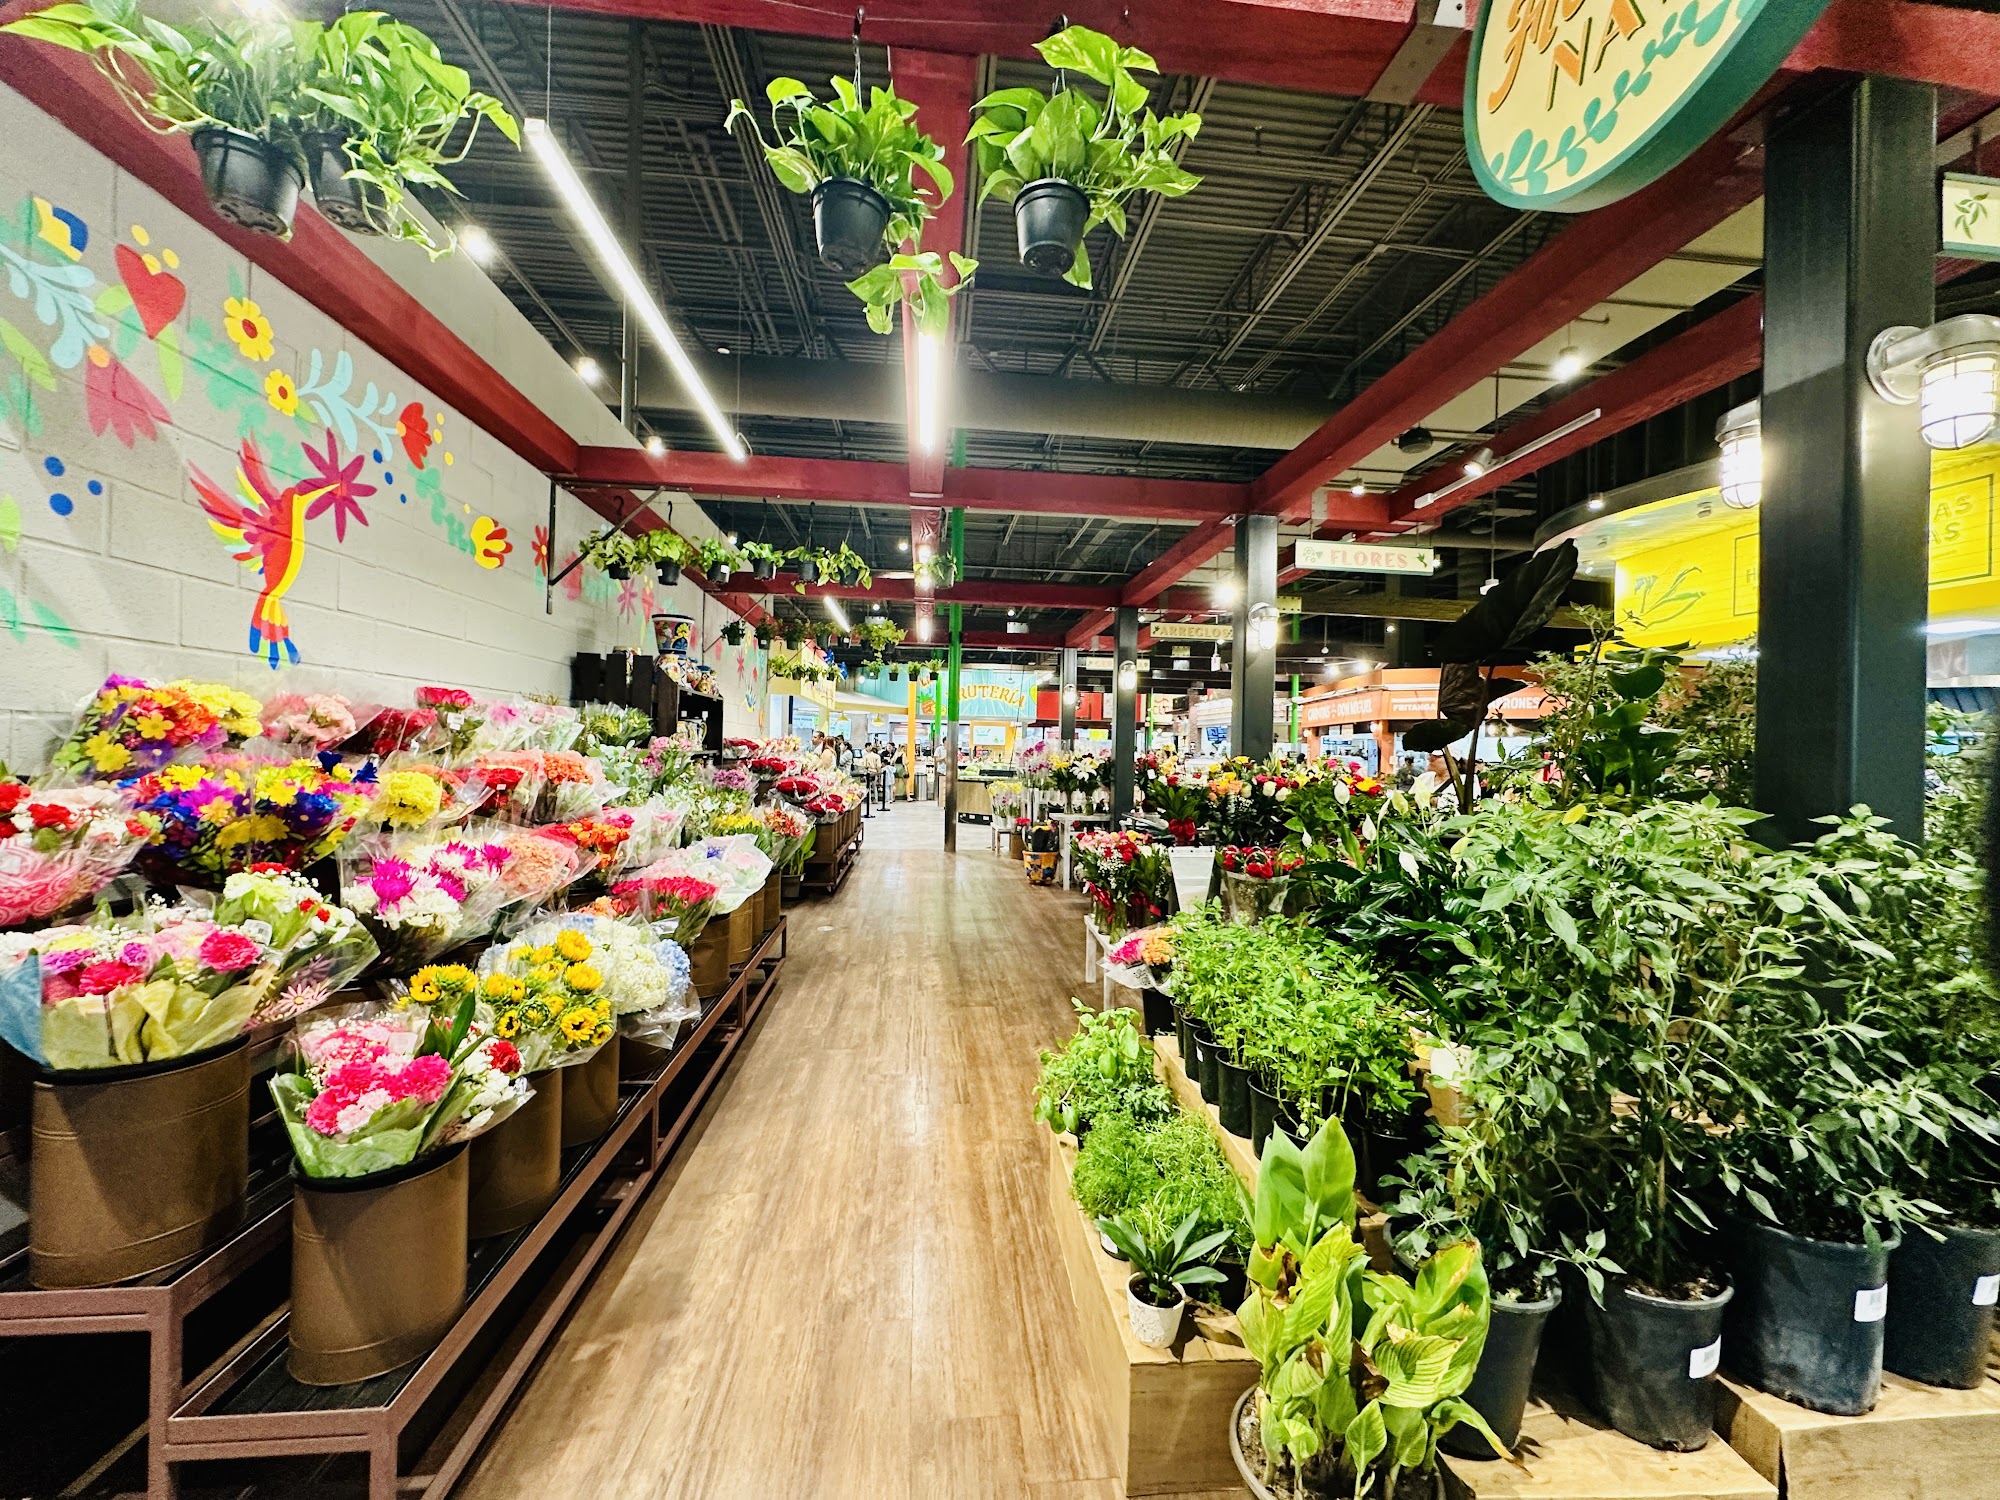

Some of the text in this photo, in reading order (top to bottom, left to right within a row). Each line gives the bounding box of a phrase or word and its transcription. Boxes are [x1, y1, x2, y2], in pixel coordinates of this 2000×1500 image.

[1546, 0, 1647, 112] NA
[1330, 549, 1408, 569] FLORES
[1159, 625, 1230, 639] ARREGLOS
[946, 684, 1025, 708] RUTERÍA
